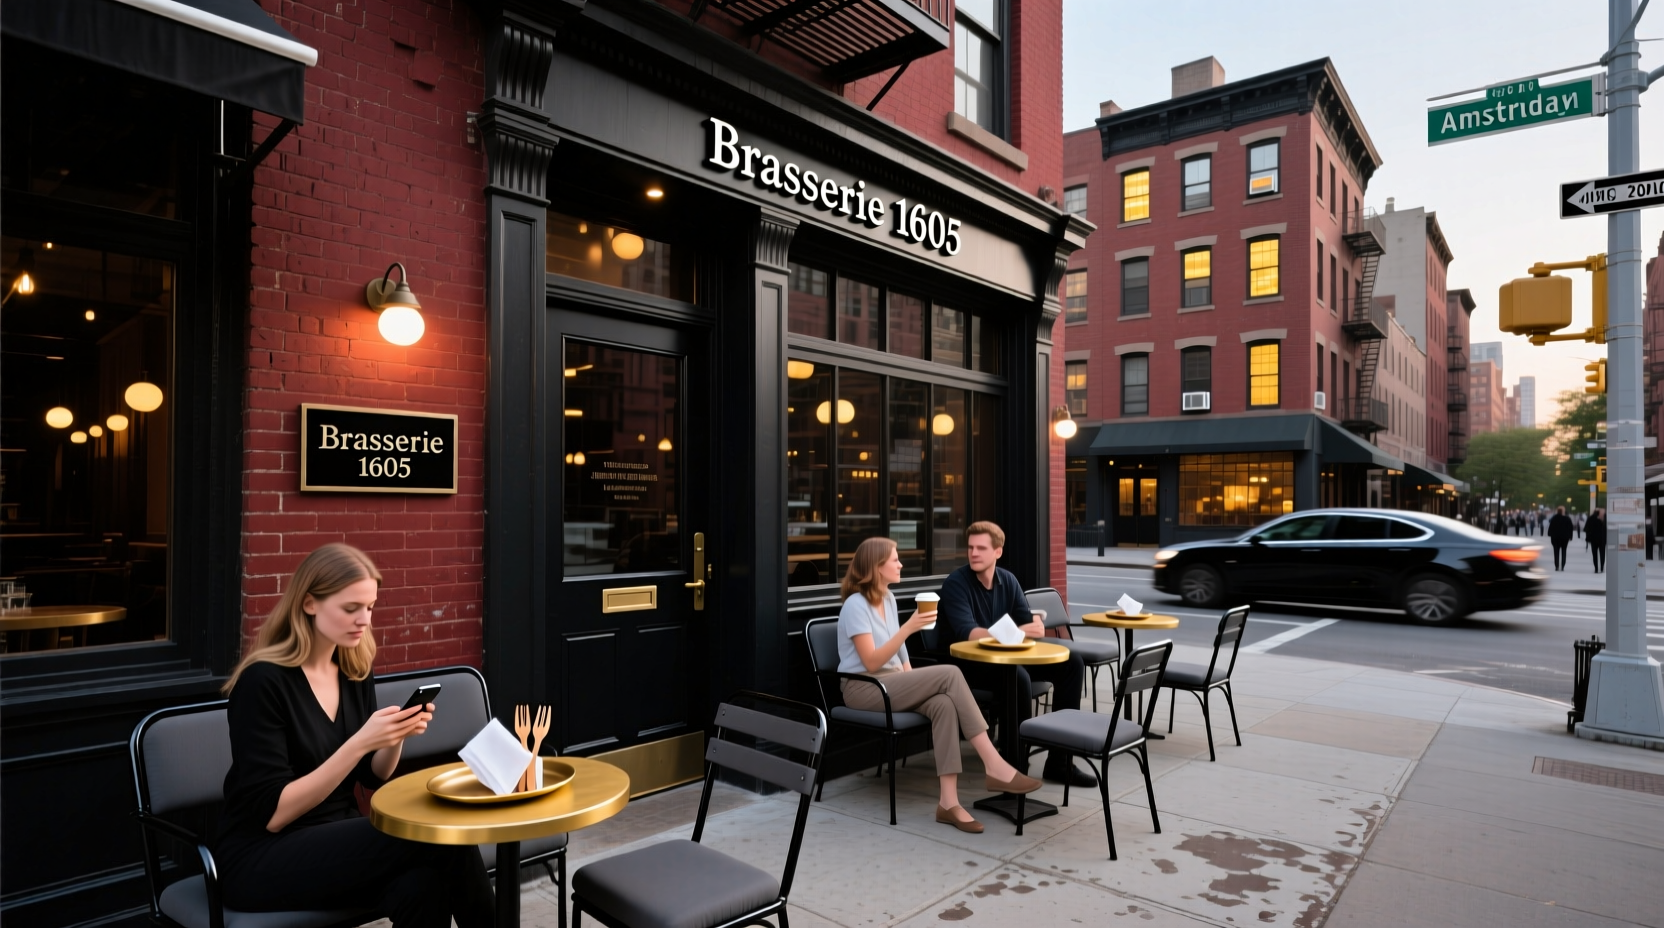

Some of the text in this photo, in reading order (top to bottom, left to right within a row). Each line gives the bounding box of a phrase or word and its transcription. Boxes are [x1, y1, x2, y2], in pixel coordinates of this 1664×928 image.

[709, 116, 962, 256] Brasserie 1605
[318, 424, 444, 454] Brasserie
[358, 456, 411, 478] 1605
